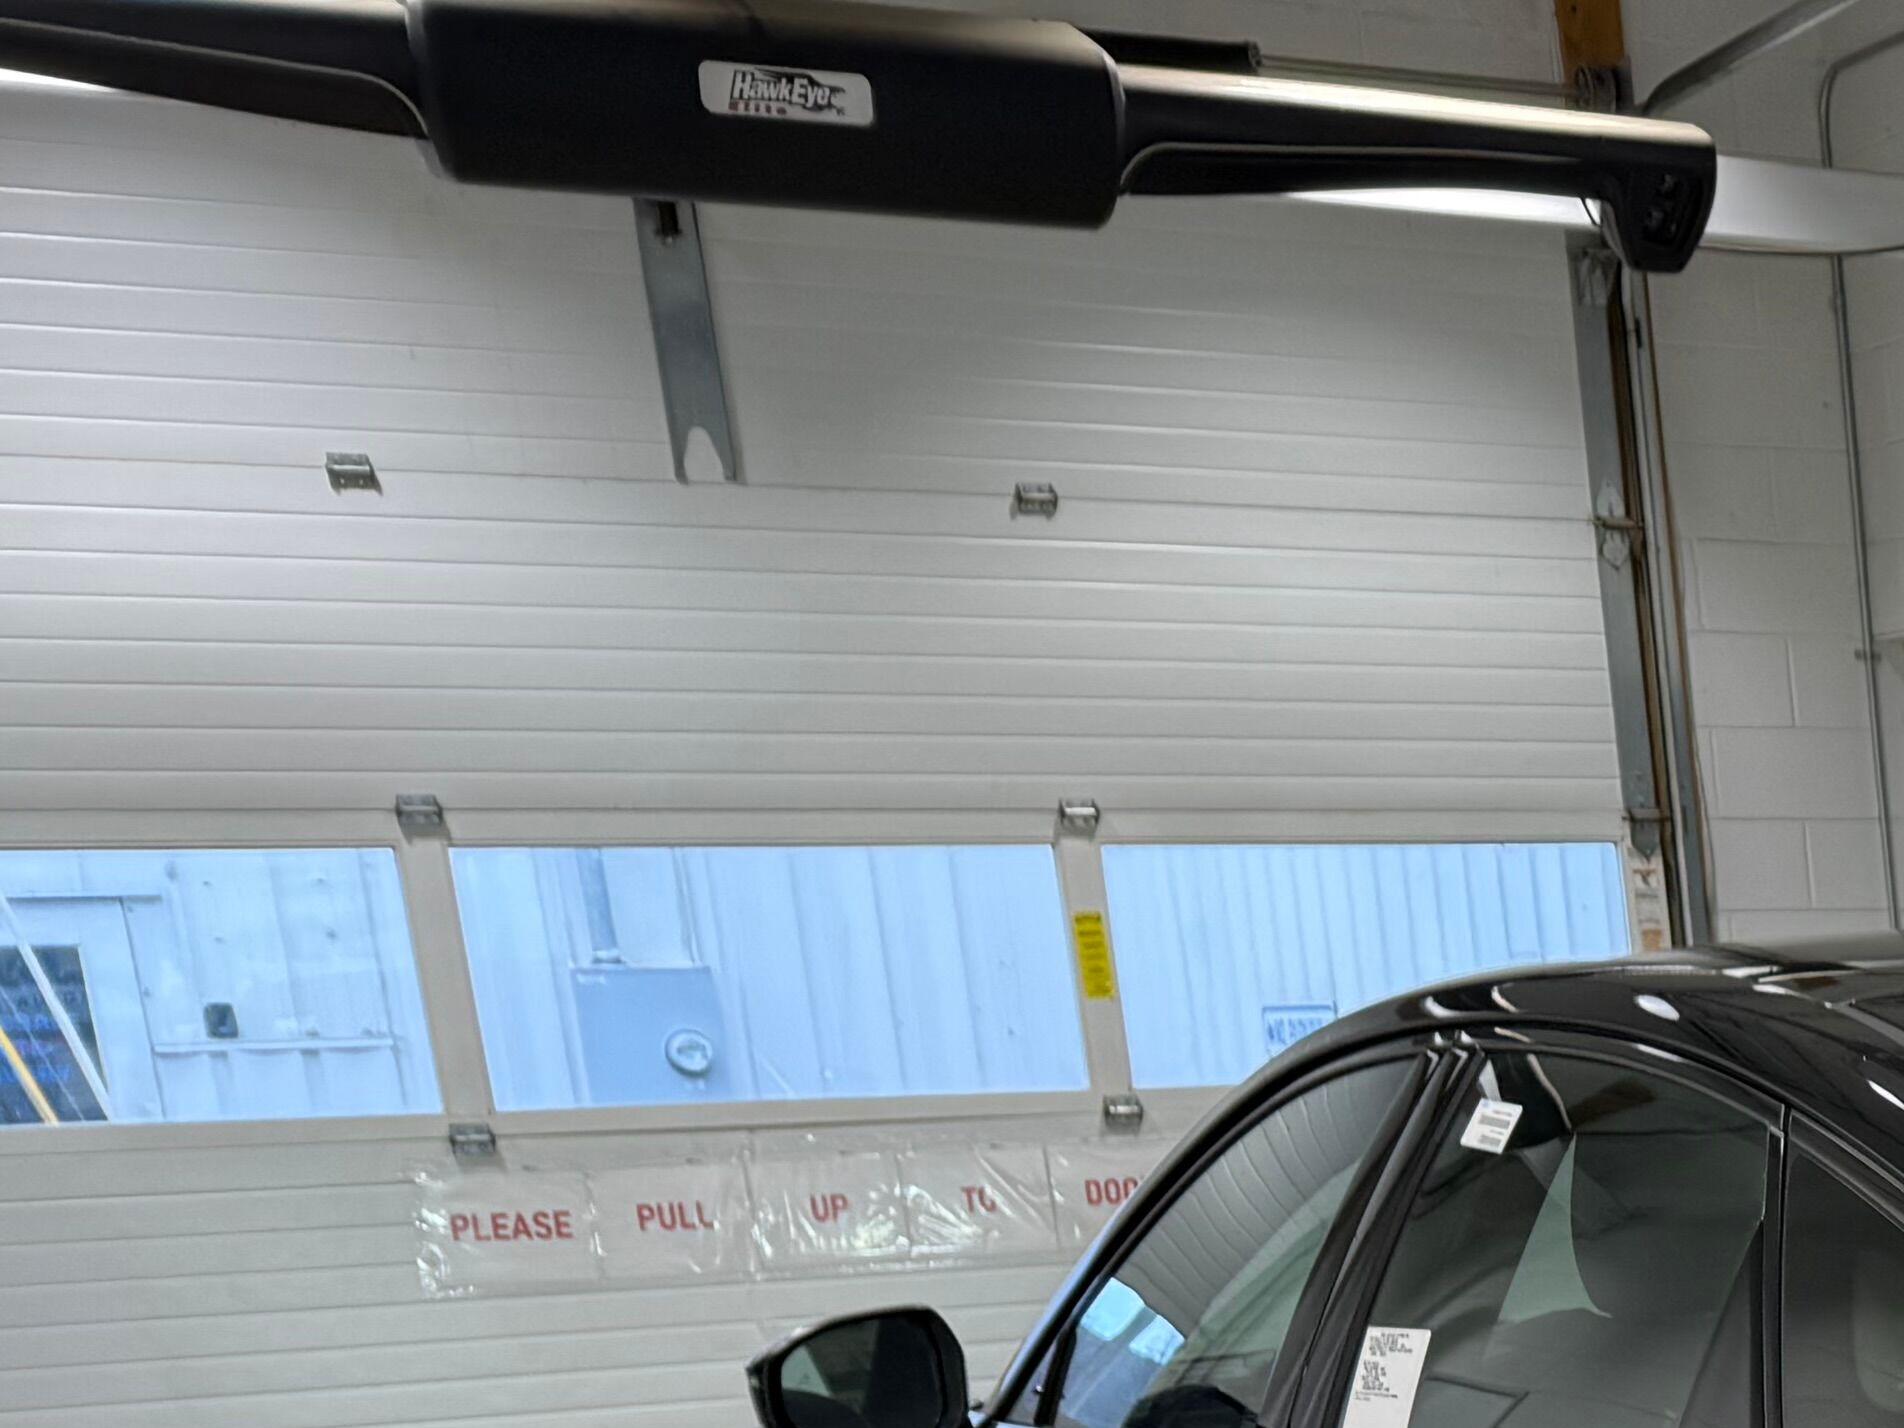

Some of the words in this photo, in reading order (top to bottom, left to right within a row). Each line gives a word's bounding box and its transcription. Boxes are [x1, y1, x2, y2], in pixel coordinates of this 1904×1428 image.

[449, 1209, 574, 1242] PLEASE
[635, 1200, 715, 1232] PULL
[810, 1192, 849, 1224] UP
